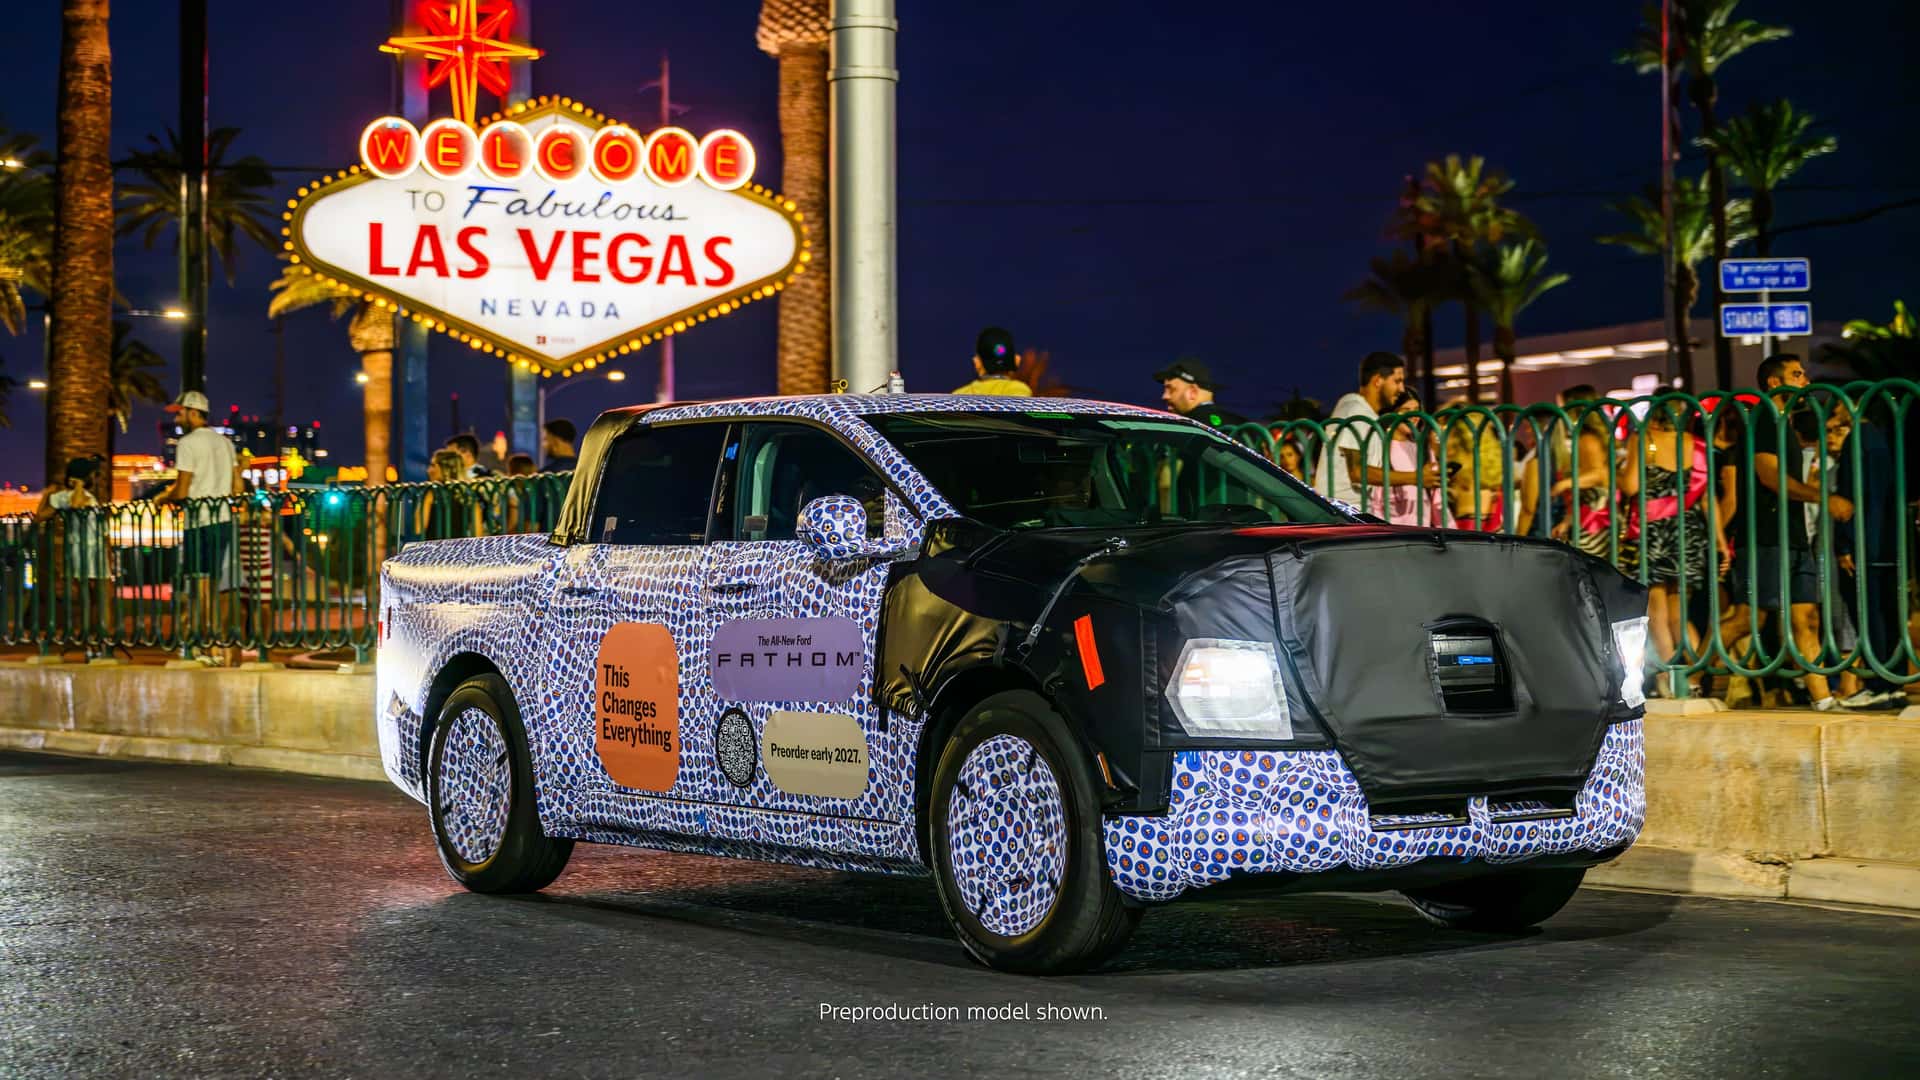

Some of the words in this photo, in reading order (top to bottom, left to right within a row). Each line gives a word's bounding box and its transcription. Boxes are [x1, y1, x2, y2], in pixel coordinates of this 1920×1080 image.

[370, 129, 740, 180] WELCOME
[406, 189, 446, 212] TO
[463, 185, 688, 221] Fabulous
[369, 222, 490, 279] LAS
[518, 229, 735, 287] VEGAS
[481, 298, 620, 320] NEVADA
[757, 635, 770, 646] The
[770, 635, 795, 646] All-New
[796, 634, 812, 646] Ford
[602, 664, 630, 688] This
[602, 691, 657, 721] Changes
[602, 718, 672, 752] Everything
[770, 743, 809, 760] Preorder
[811, 745, 833, 763] early
[834, 747, 862, 763] 2027.
